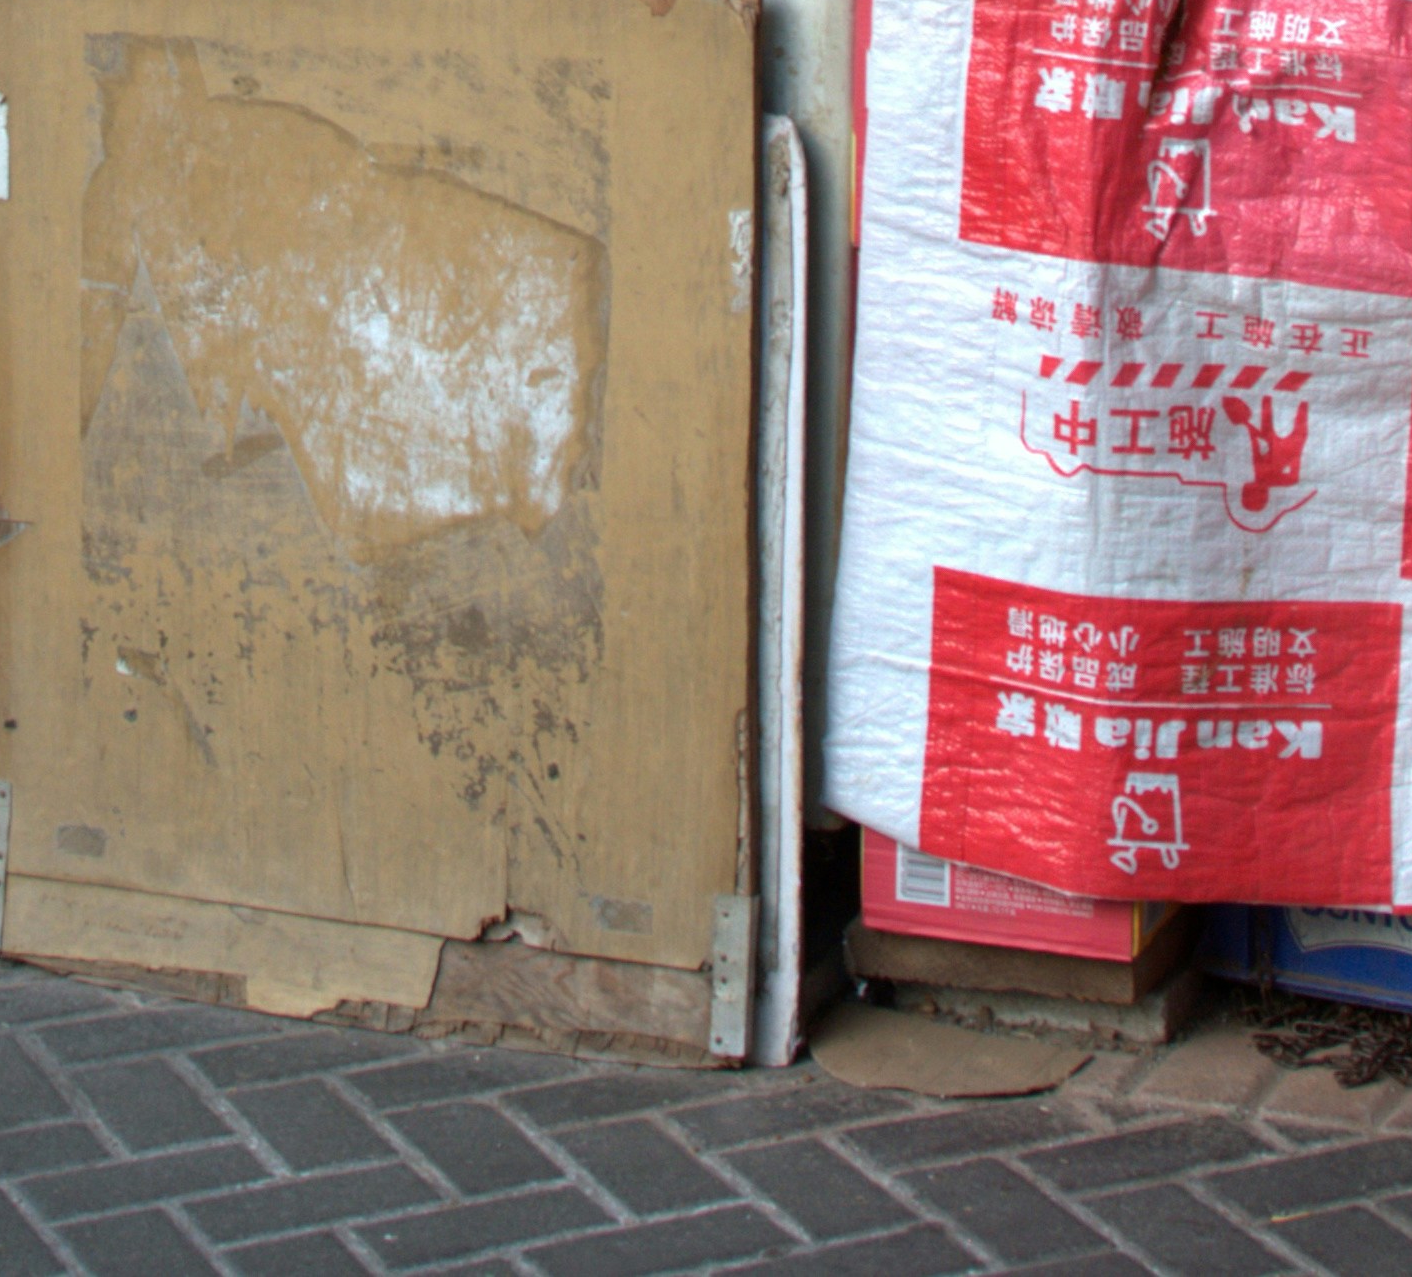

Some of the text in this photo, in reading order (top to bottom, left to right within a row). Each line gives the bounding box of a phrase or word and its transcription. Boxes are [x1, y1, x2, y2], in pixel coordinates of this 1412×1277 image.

[1213, 7, 1346, 47] 文明施工
[1209, 41, 1344, 82] 标准工程
[990, 287, 1373, 360] 正在施工 敬请谅解
[1051, 399, 1217, 461] 施工中
[1006, 606, 1140, 658] 小心地滑
[1181, 625, 1318, 659] 文明施工
[1005, 643, 1138, 692] 成品保护
[1179, 662, 1317, 696] 标准工程
[1094, 715, 1187, 761] Jia
[1196, 719, 1324, 761] Kan
